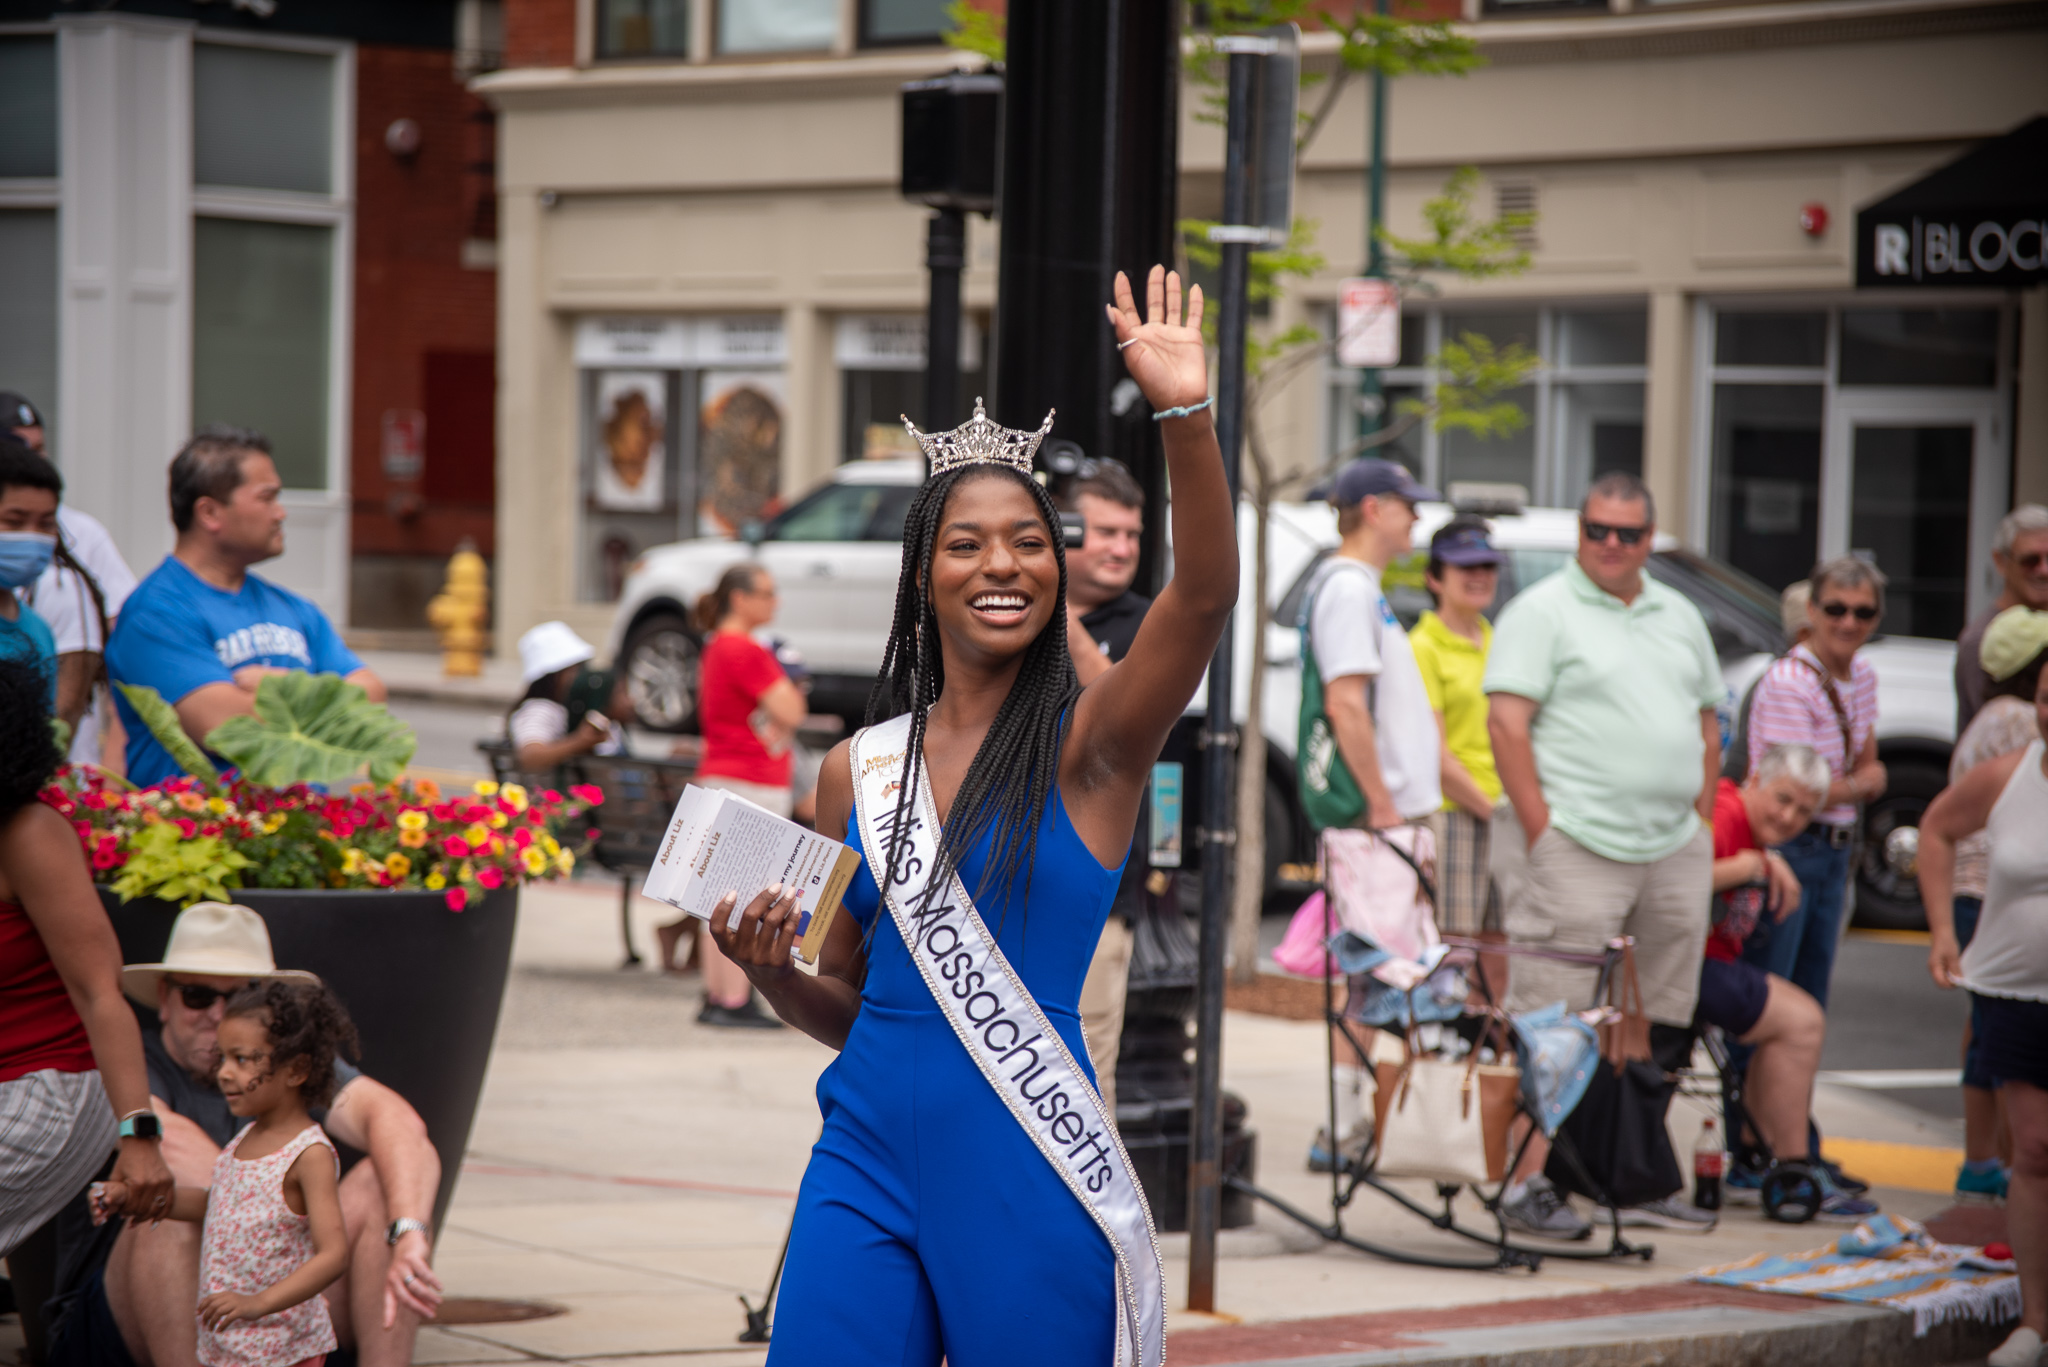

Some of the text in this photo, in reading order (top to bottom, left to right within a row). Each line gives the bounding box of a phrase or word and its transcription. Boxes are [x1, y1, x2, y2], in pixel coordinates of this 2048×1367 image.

[865, 753, 894, 768] Miss
[660, 818, 684, 866] About Liz
[697, 847, 715, 878] About
[710, 830, 722, 846] Liz
[784, 834, 806, 876] my journey
[796, 839, 816, 878] Massachusetts
[872, 800, 1113, 1194] Miss Massachusetts
